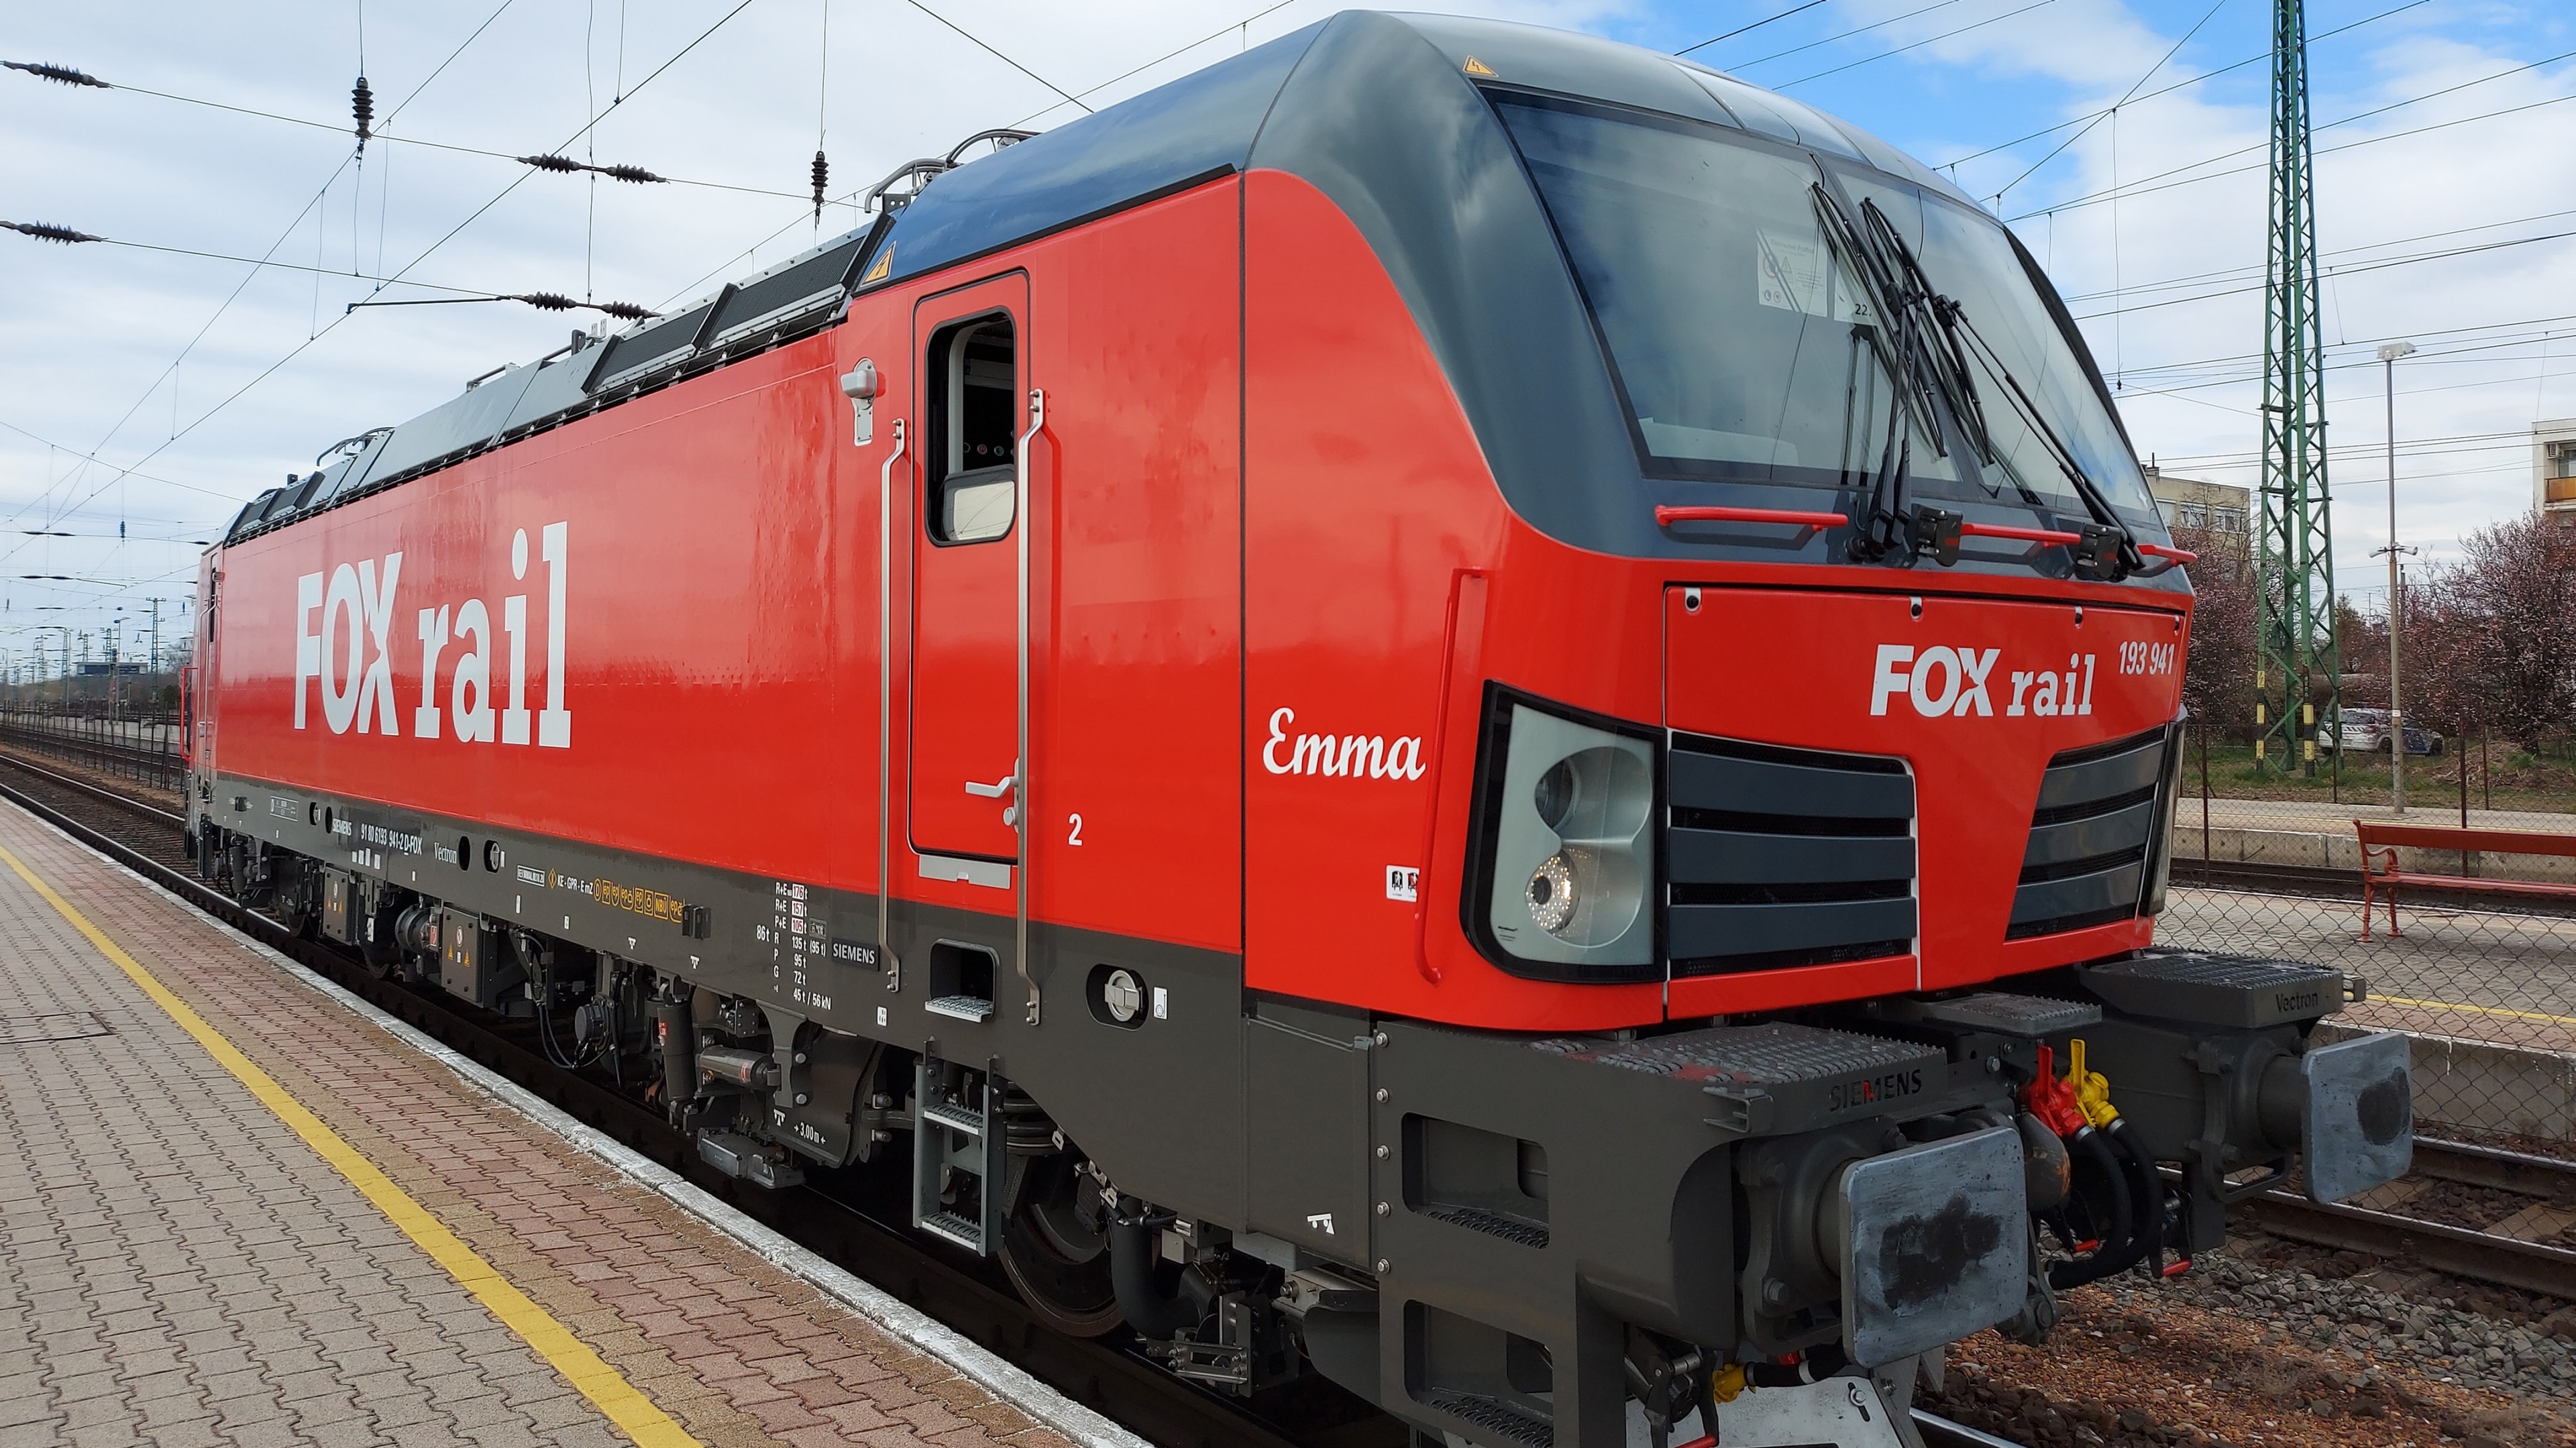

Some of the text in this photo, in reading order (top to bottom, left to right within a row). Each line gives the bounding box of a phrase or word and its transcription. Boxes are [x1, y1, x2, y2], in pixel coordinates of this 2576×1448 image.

[294, 521, 571, 748] FOX rail
[2119, 641, 2176, 675] 193 941
[1870, 644, 2096, 717] FOX rail
[1263, 707, 1426, 781] Emma
[333, 818, 352, 836] SIEMENS
[1068, 813, 1083, 846] 2
[361, 823, 367, 840] 91
[375, 826, 387, 846] 6193
[389, 830, 403, 850] 941-2
[405, 834, 423, 856] D-FOX
[434, 842, 457, 865] Vectron
[794, 886, 803, 899] 176
[793, 903, 802, 915] 157
[792, 919, 802, 932] 105
[774, 932, 779, 944] R
[774, 948, 779, 961] P
[833, 943, 875, 964] SIEMENS
[773, 965, 779, 977] G
[2276, 992, 2318, 1013] Vectron
[1829, 1069, 1922, 1112] SIEMENS
